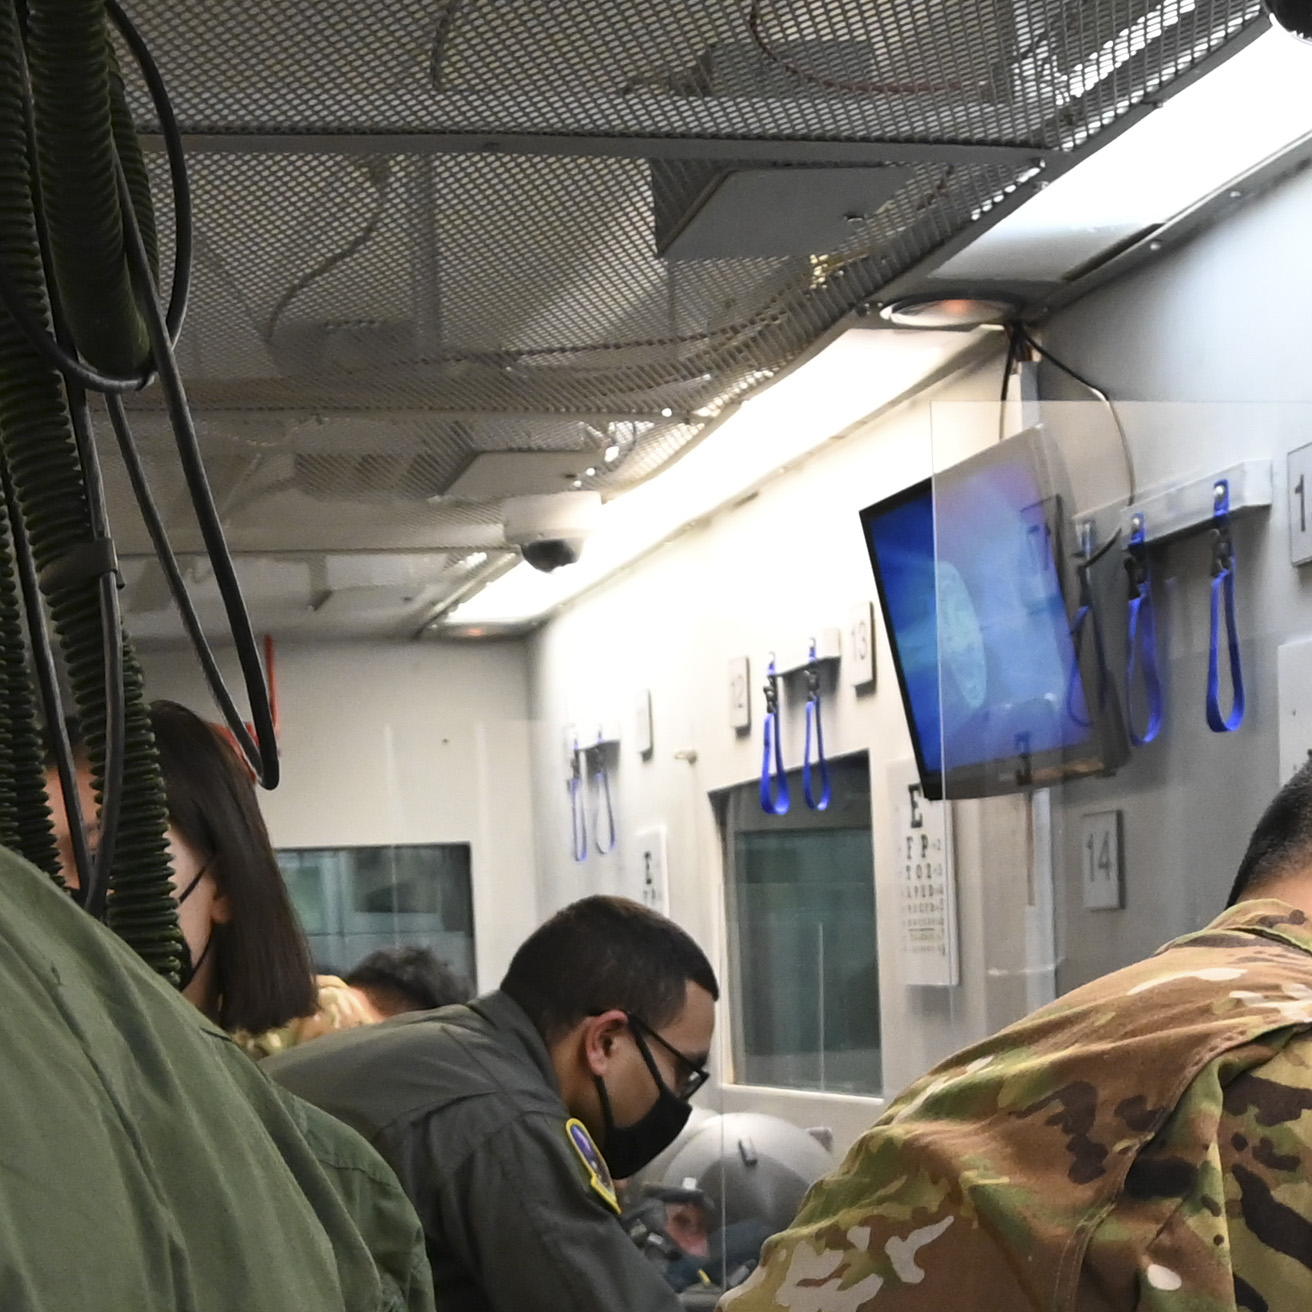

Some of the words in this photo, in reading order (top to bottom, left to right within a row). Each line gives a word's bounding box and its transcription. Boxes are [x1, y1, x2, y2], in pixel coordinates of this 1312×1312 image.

[851, 620, 868, 661] 13
[908, 783, 923, 828] E
[1087, 831, 1112, 881] 14
